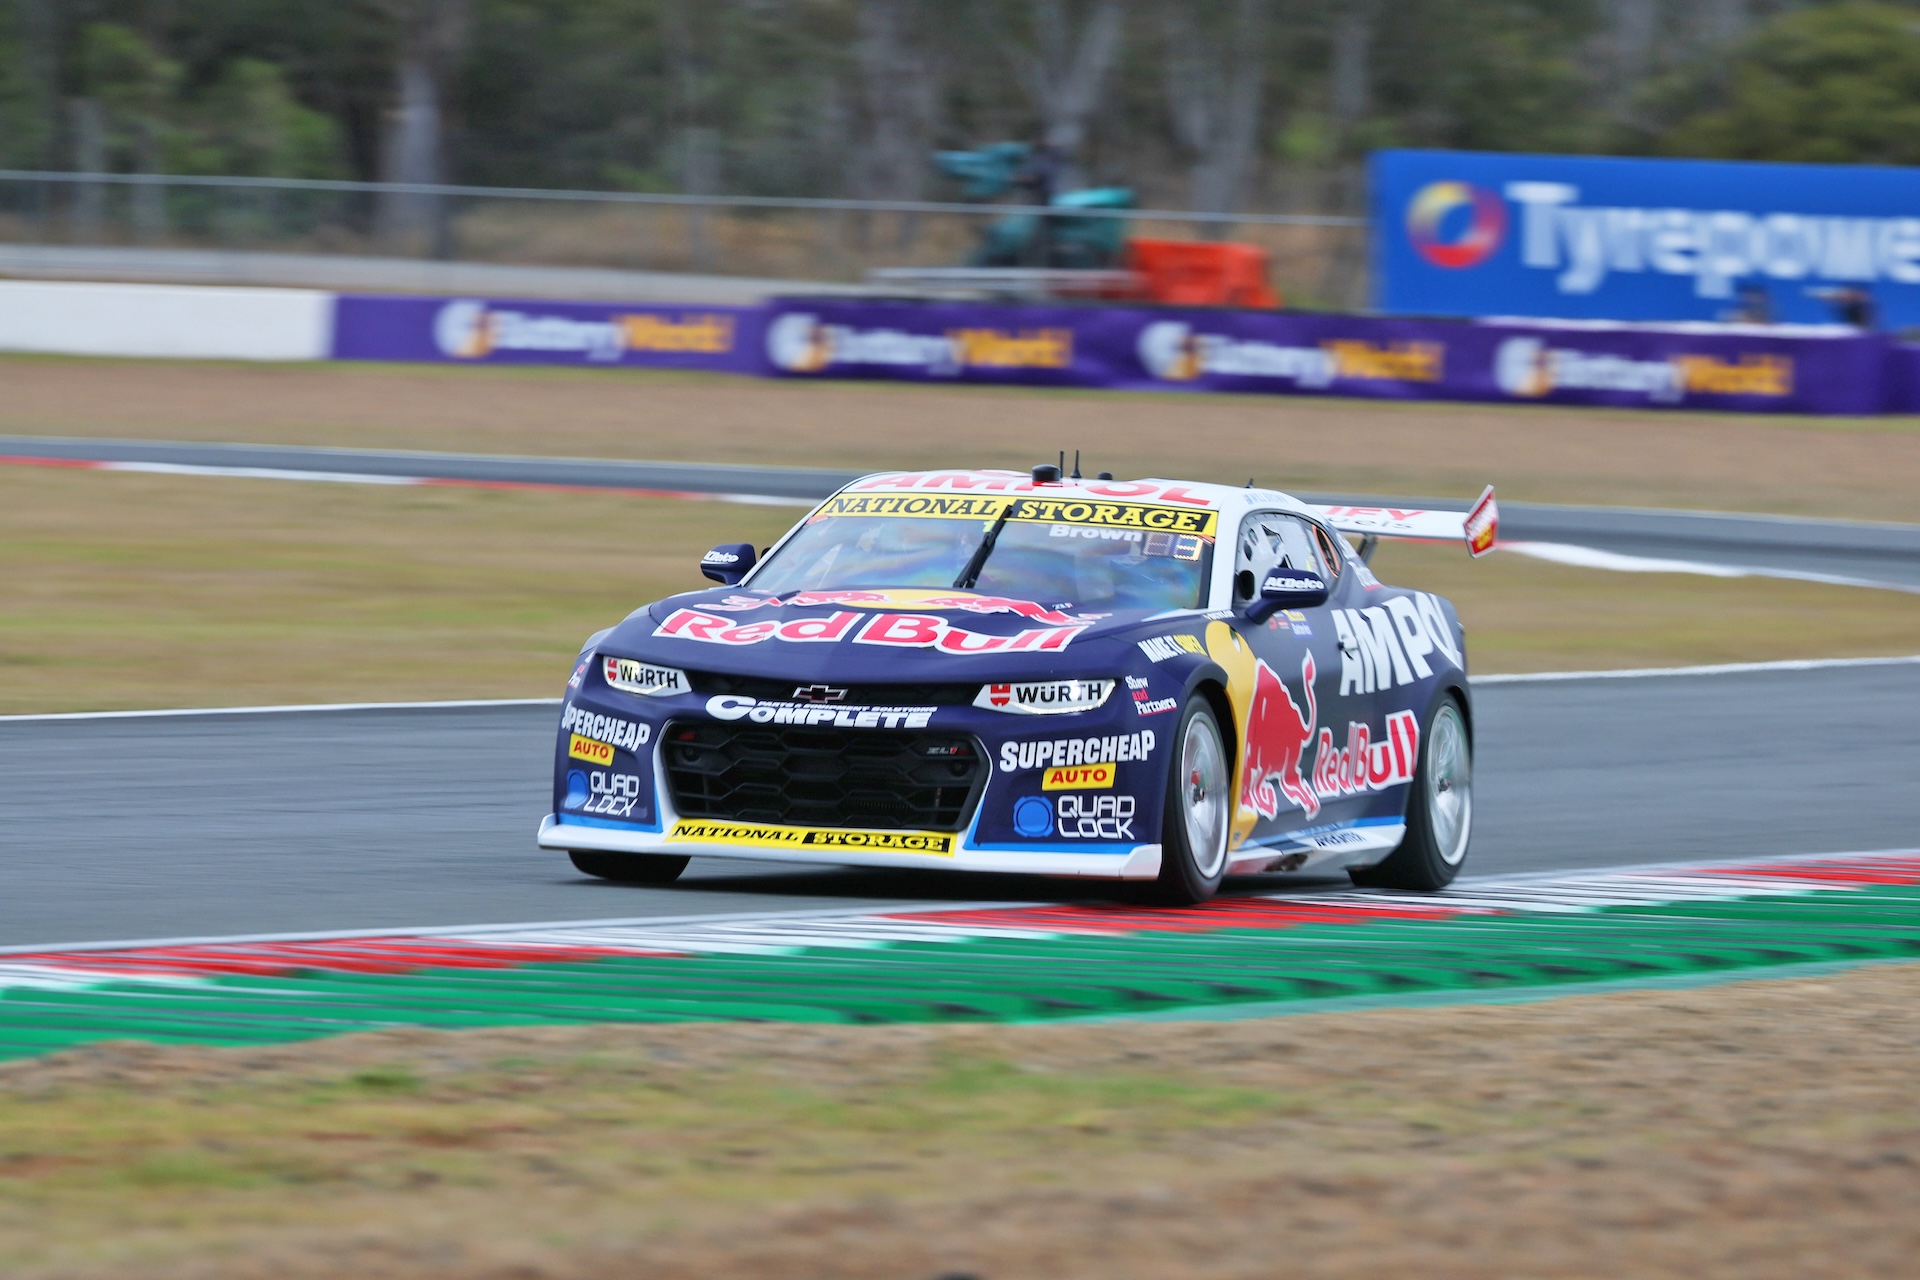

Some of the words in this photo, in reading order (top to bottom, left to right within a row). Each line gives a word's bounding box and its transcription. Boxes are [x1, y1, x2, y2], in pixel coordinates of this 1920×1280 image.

[855, 474, 1211, 505] AMPOL
[825, 497, 999, 516] NATIONAL
[1017, 500, 1203, 532] STORAGE
[1049, 524, 1143, 542] Brown
[1265, 576, 1325, 590] ACDelco
[653, 608, 866, 646] Red
[852, 612, 1088, 655] Bull
[620, 663, 679, 689] WÜRTH
[1125, 675, 1149, 690] Shaw
[1131, 688, 1149, 701] and
[1134, 697, 1177, 715] Partners
[705, 695, 933, 729] COMPLETE
[573, 740, 609, 759] AUTO
[1000, 729, 1155, 772] SUPERCHEAP
[1312, 721, 1358, 798] Red
[1352, 709, 1420, 793] Bull
[589, 770, 640, 798] QUAD
[1050, 768, 1107, 784] AUTO
[583, 793, 639, 818] LOCK
[1057, 795, 1136, 819] QUAD
[672, 825, 800, 843] NATIONAL
[813, 831, 944, 851] STORAGE
[1057, 817, 1136, 840] LOCK
